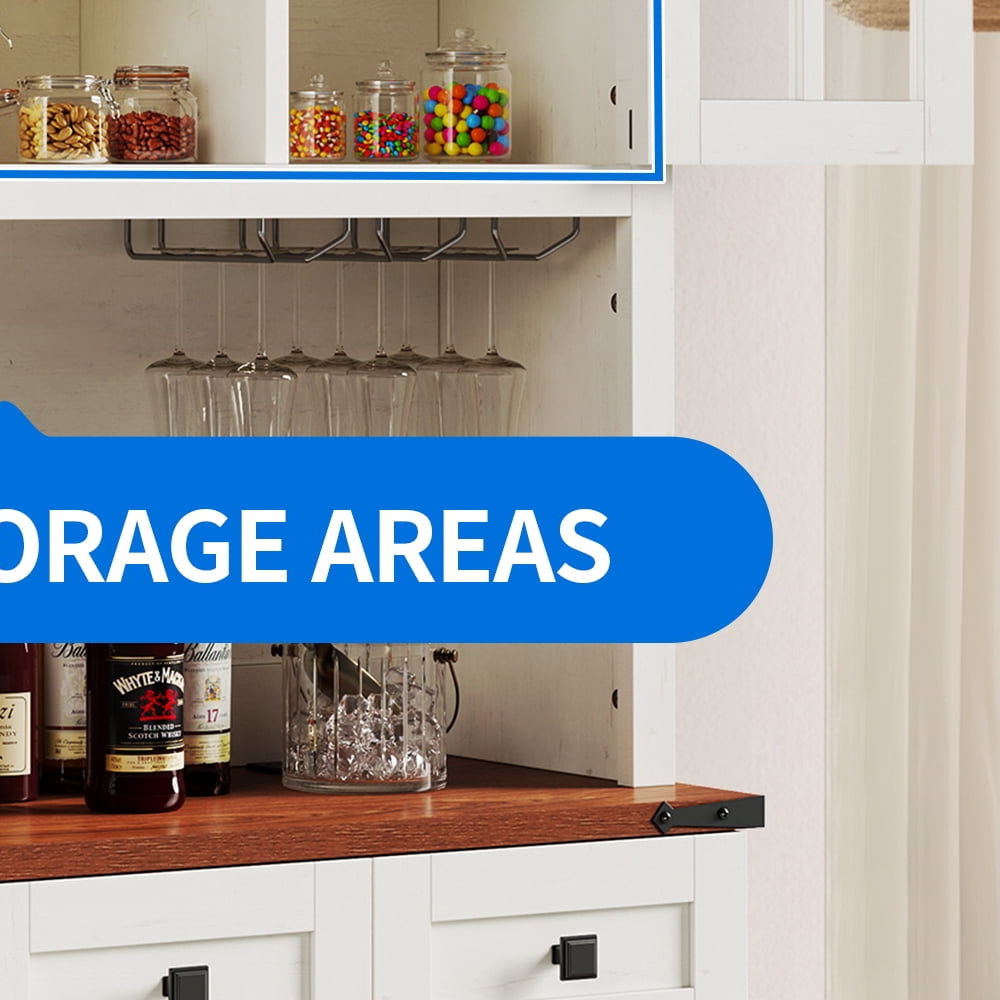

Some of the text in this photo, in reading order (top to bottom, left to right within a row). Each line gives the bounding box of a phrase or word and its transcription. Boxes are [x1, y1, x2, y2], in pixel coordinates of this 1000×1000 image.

[112, 670, 155, 695] WHYTE
[154, 670, 161, 682] &
[206, 708, 220, 723] 17
[142, 723, 176, 731] BLENDED
[127, 732, 160, 740] SCOTCH
